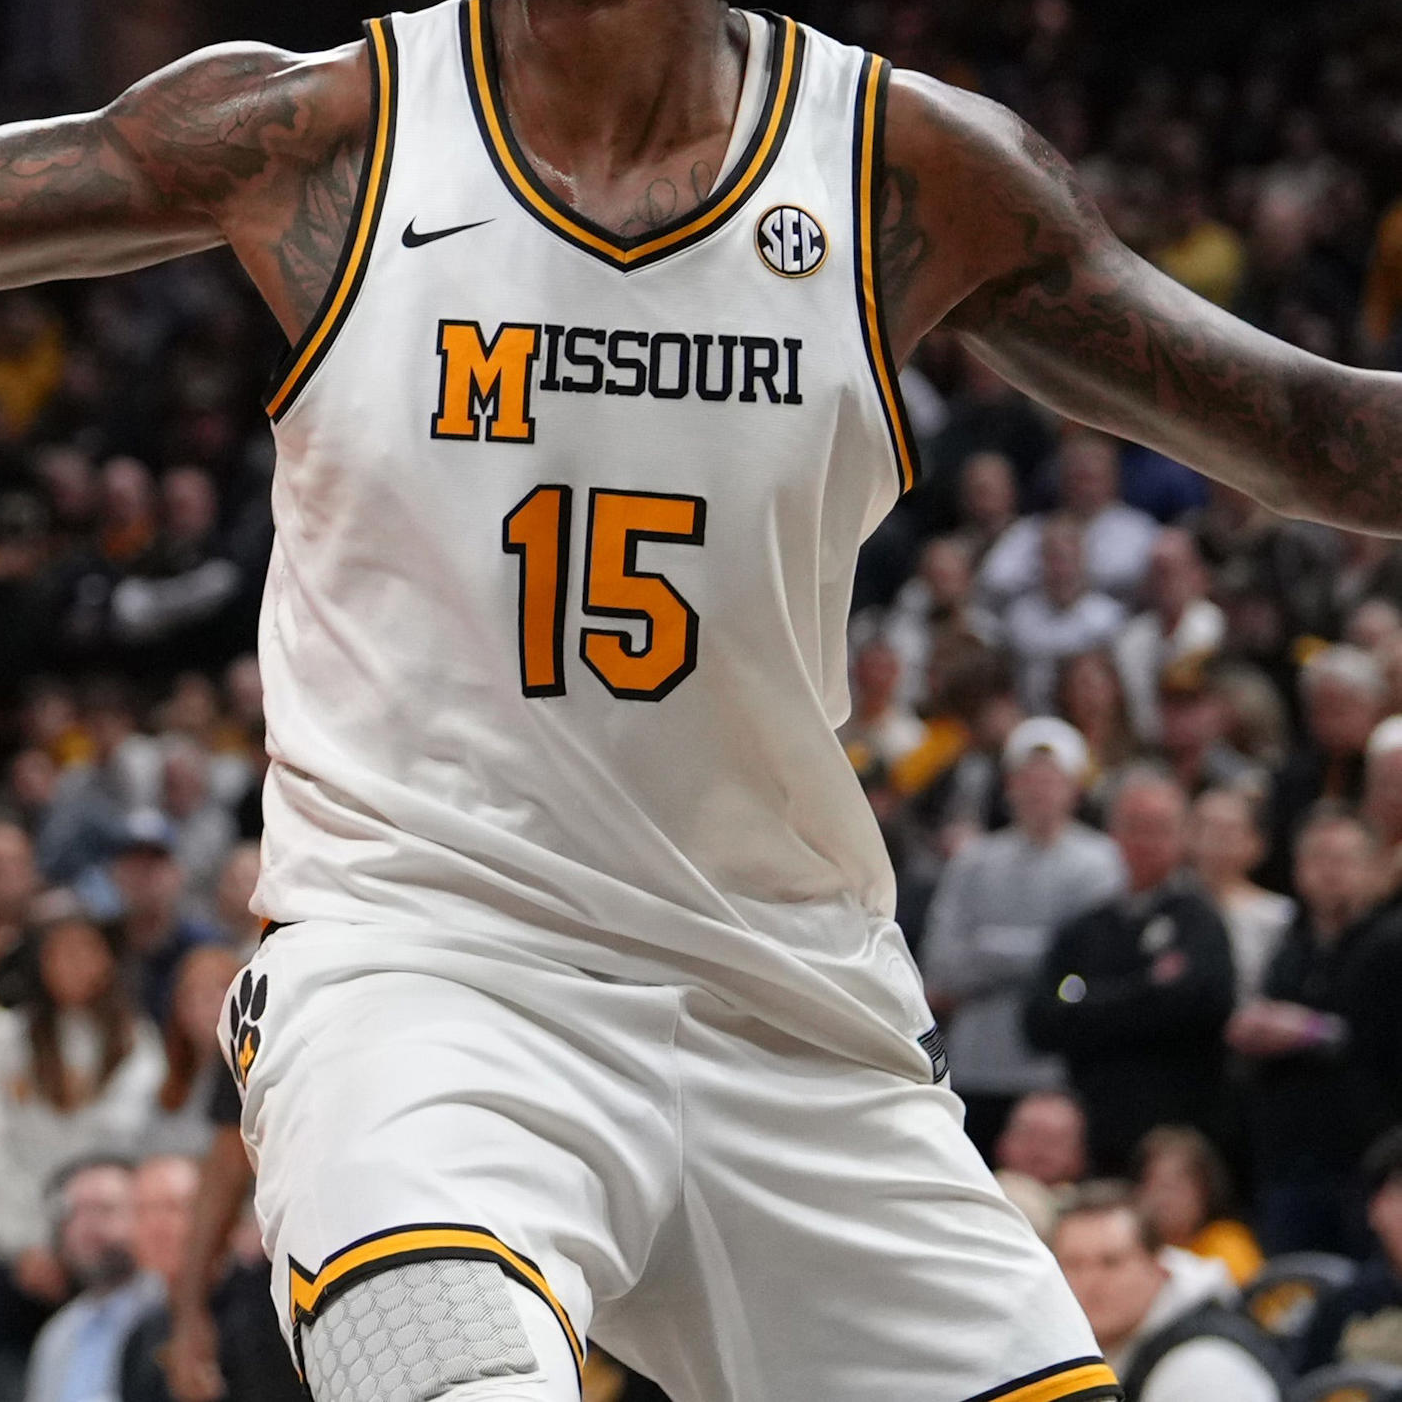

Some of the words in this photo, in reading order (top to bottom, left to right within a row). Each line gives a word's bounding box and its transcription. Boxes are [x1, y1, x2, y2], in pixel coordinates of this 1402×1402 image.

[760, 208, 823, 273] SEC
[430, 319, 803, 445] MISSOURI
[502, 484, 706, 702] 15
